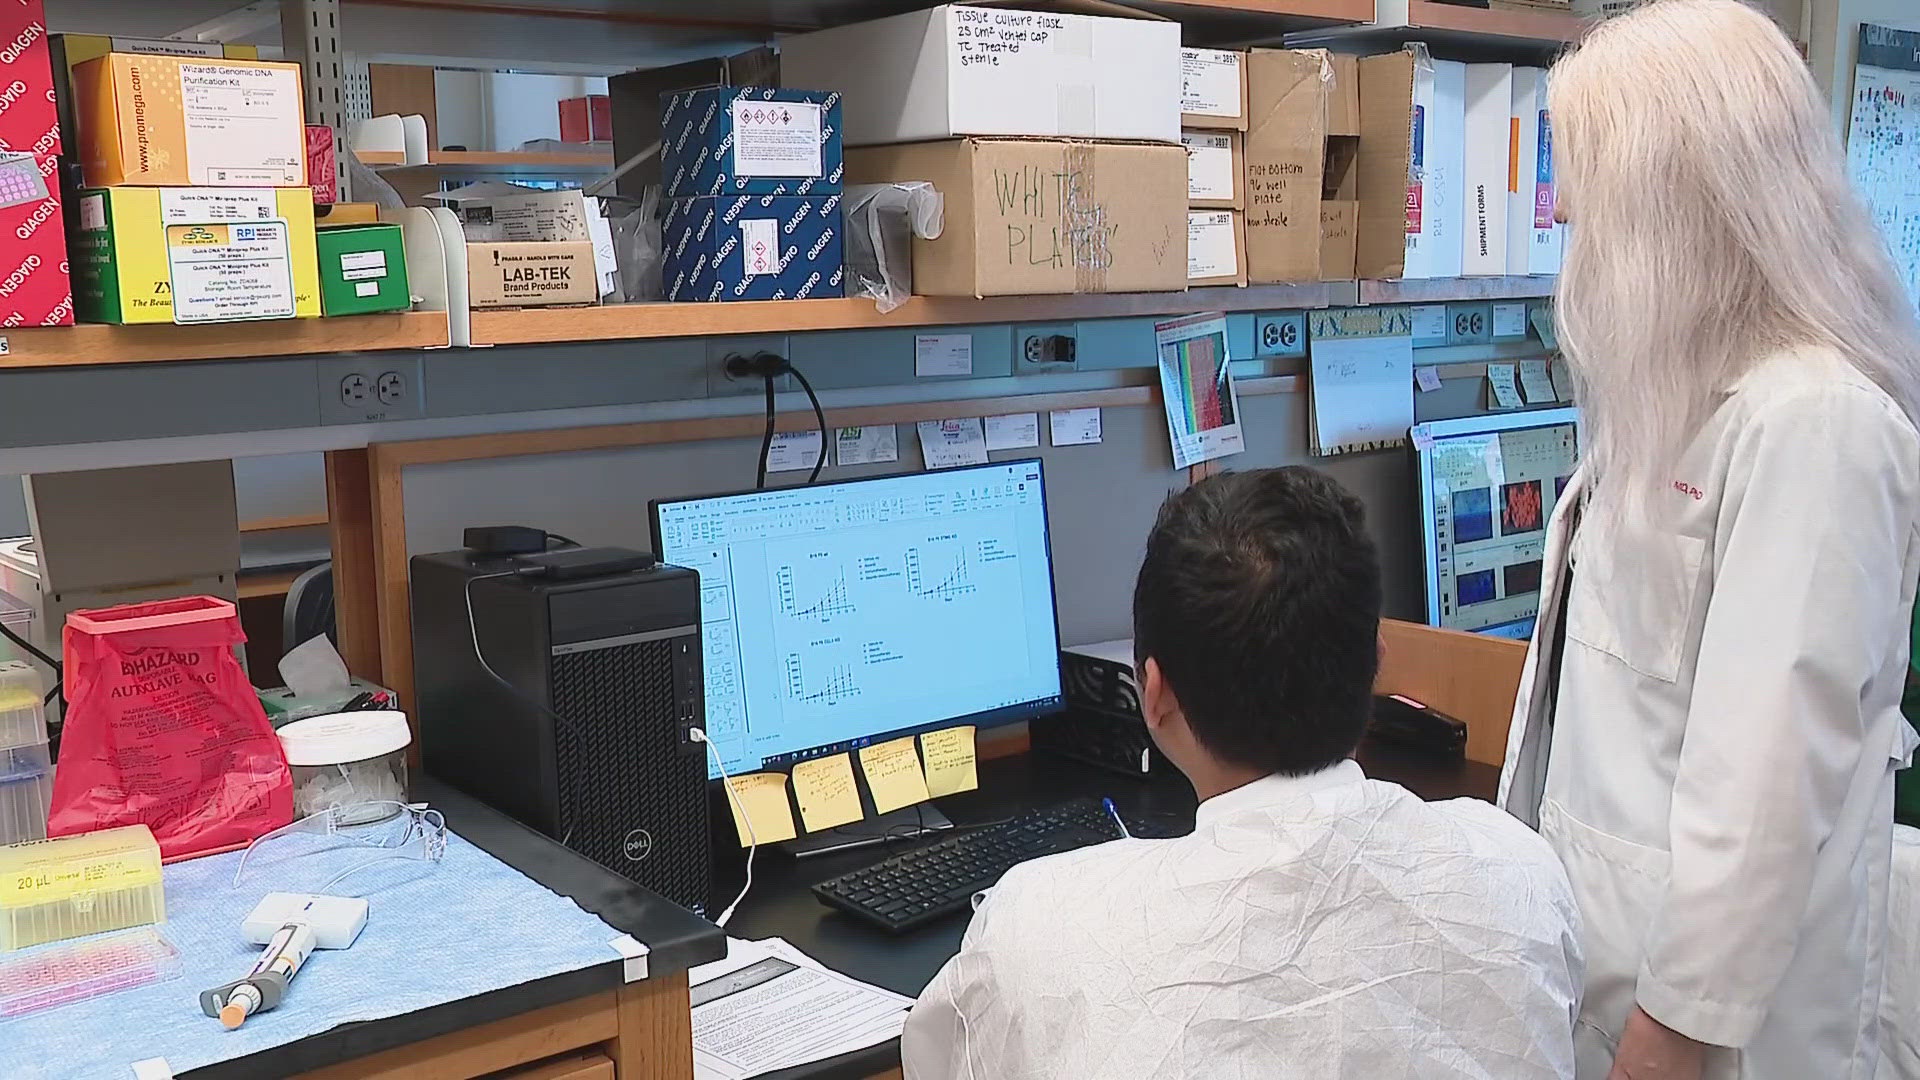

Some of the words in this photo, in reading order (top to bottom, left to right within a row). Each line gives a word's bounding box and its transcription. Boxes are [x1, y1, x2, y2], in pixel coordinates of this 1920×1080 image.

[955, 11, 989, 24] Tissue
[995, 15, 1032, 26] culture
[1036, 15, 1064, 29] flask
[957, 26, 972, 37] 25
[0, 21, 44, 64] QIAGEN
[957, 41, 973, 52] TC
[183, 76, 227, 87] Purification
[229, 79, 240, 87] Kit
[218, 67, 253, 77] Genomic
[255, 69, 273, 77] DNA
[131, 67, 149, 173] www.promega.com
[662, 95, 679, 128] QIAGEN
[698, 100, 718, 135] QIAGEN
[675, 120, 693, 154] QIAGEN
[690, 146, 709, 180] QIAGEN
[1249, 165, 1266, 176] Flat
[668, 164, 686, 197] QIAGEN
[994, 165, 1085, 218] WHITE
[1249, 179, 1261, 190] 96
[1266, 179, 1287, 190] well
[722, 194, 751, 225] QIAGEN
[1477, 184, 1486, 210] FORMS
[16, 197, 60, 239] QIAGEN
[236, 228, 256, 238] RPI
[663, 201, 679, 233] QIAGEN
[696, 208, 715, 242] QIAGEN
[784, 201, 812, 234] QIAGEN
[675, 226, 692, 260] QIAGEN
[807, 228, 834, 261] QIAGEN
[1477, 212, 1488, 256] SHIPMENT
[711, 235, 739, 269] QIAGEN
[0, 255, 41, 298] QIAGEN
[503, 266, 571, 282] LAB-TEK
[669, 270, 685, 301] QIAGEN
[689, 253, 707, 287] QIAGEN
[132, 298, 149, 307] The
[503, 283, 530, 292] Brand
[531, 281, 569, 291] Products
[627, 840, 649, 850] DELL
[17, 877, 33, 890] 20
